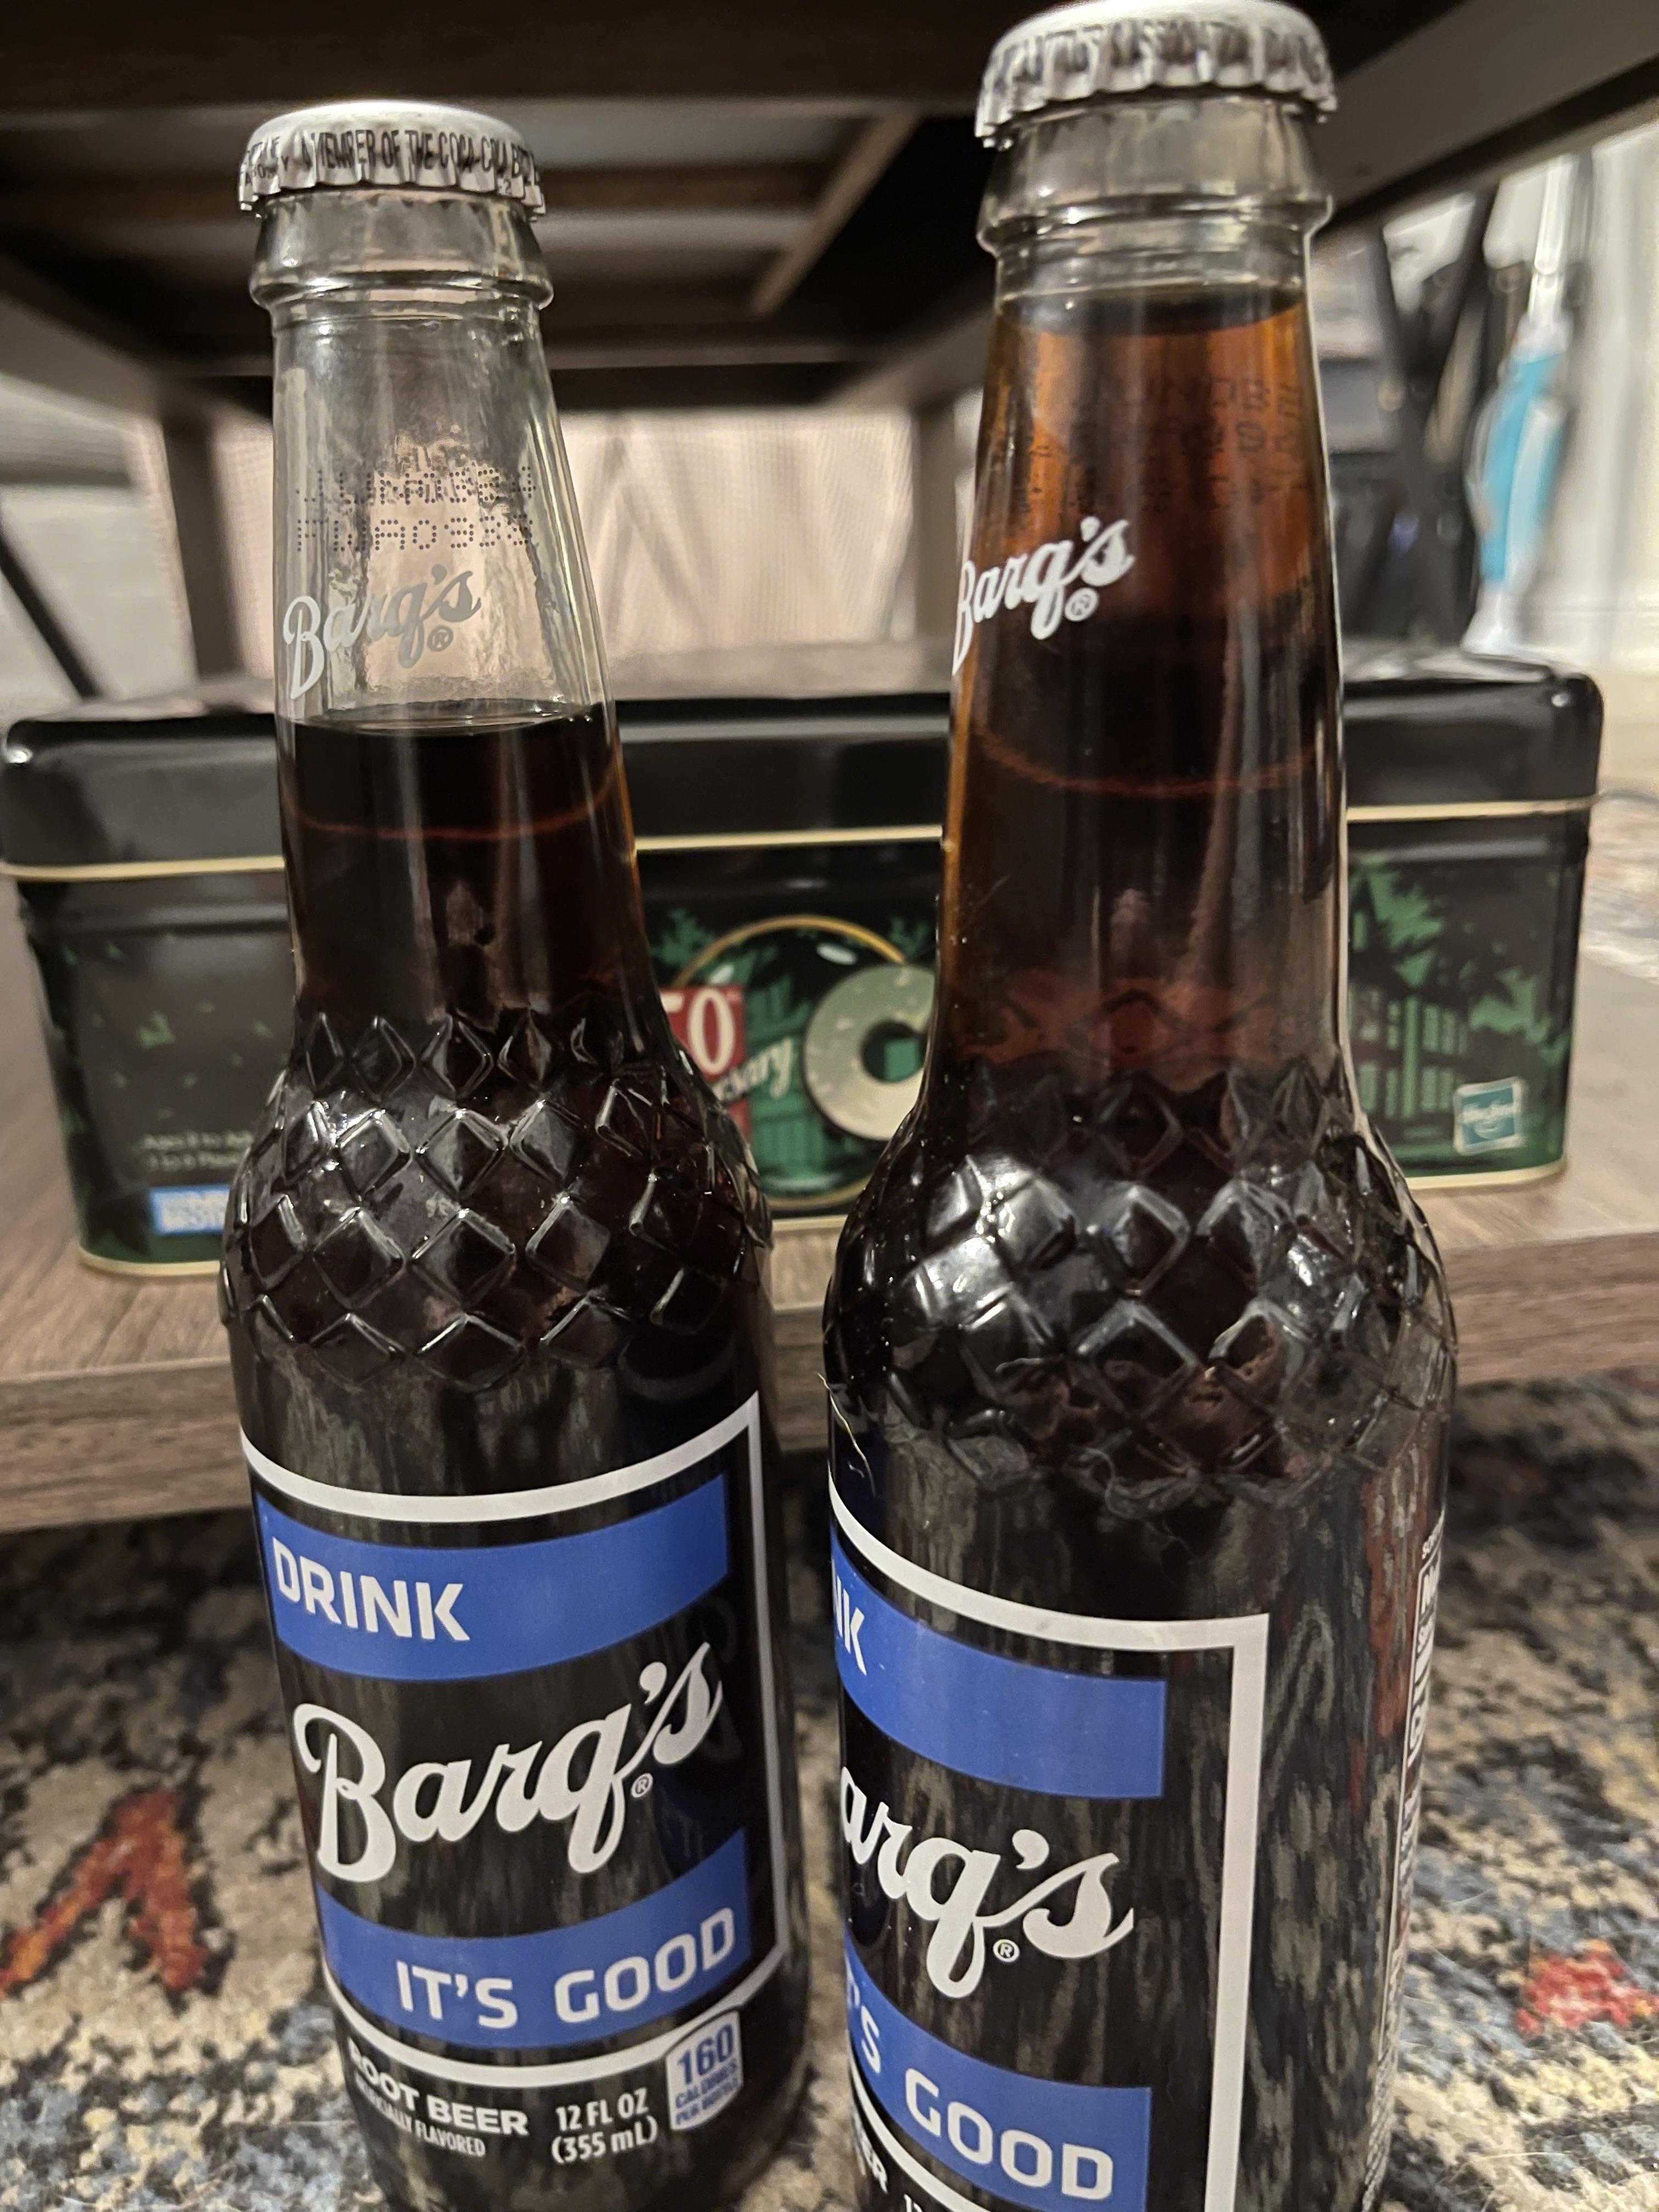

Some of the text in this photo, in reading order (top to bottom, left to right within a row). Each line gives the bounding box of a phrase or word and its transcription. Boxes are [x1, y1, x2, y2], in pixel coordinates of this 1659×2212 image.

[313, 129, 376, 170] MEMBER
[381, 130, 399, 168] OF
[404, 129, 433, 170] THE
[283, 563, 482, 700] Barq's
[272, 1537, 470, 1641] DRINK
[293, 1641, 723, 1882] Barq's
[841, 1766, 1134, 1999] arq's
[396, 1907, 736, 2029] IT'S GOOD
[347, 2036, 531, 2136] ROOT BEER
[678, 2023, 733, 2084] 160
[414, 2119, 486, 2158] FLAVORED
[551, 2114, 658, 2164] (355 mL)
[556, 2087, 649, 2131] 12 FL OZ
[905, 2068, 1114, 2201] GOOD
